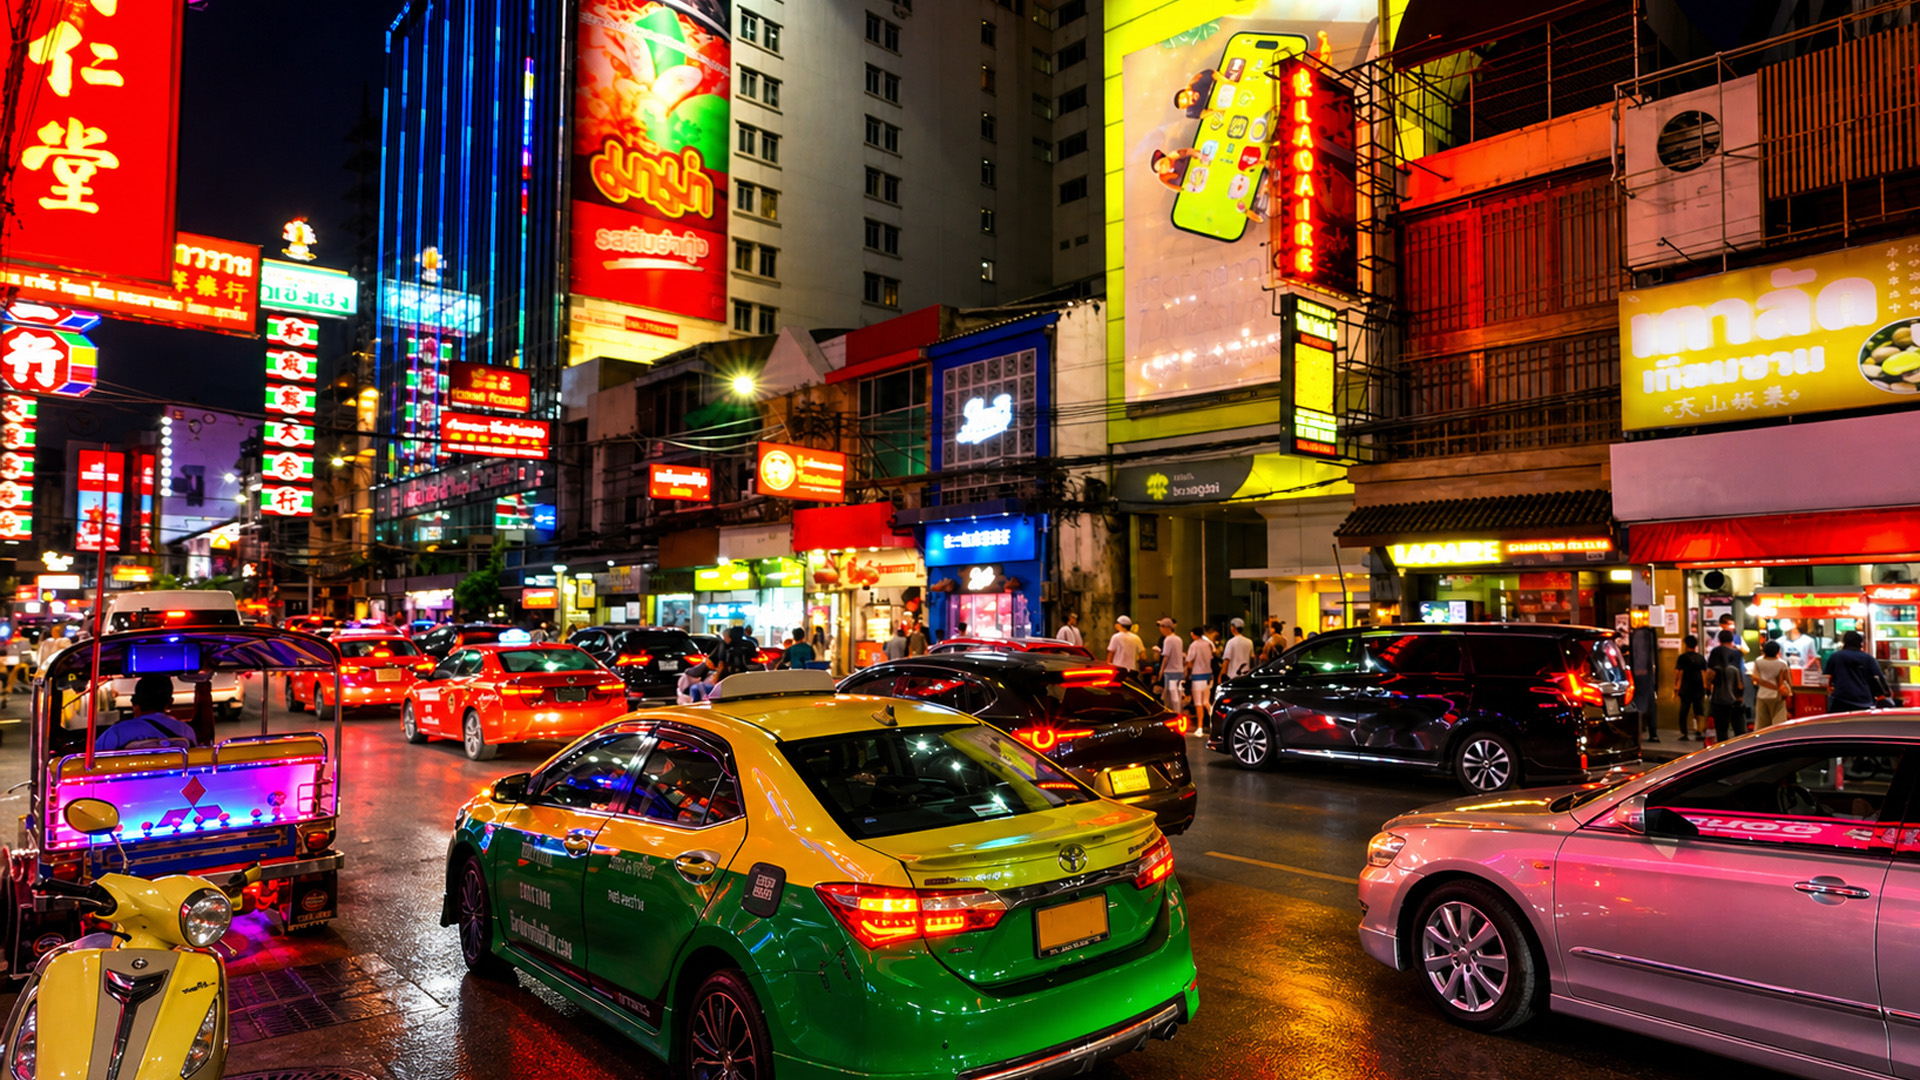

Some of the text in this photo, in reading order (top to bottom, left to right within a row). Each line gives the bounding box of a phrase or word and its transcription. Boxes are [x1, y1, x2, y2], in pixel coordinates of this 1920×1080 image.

[22, 0, 125, 214] 仁堂
[1631, 268, 1878, 358] เกาลัด
